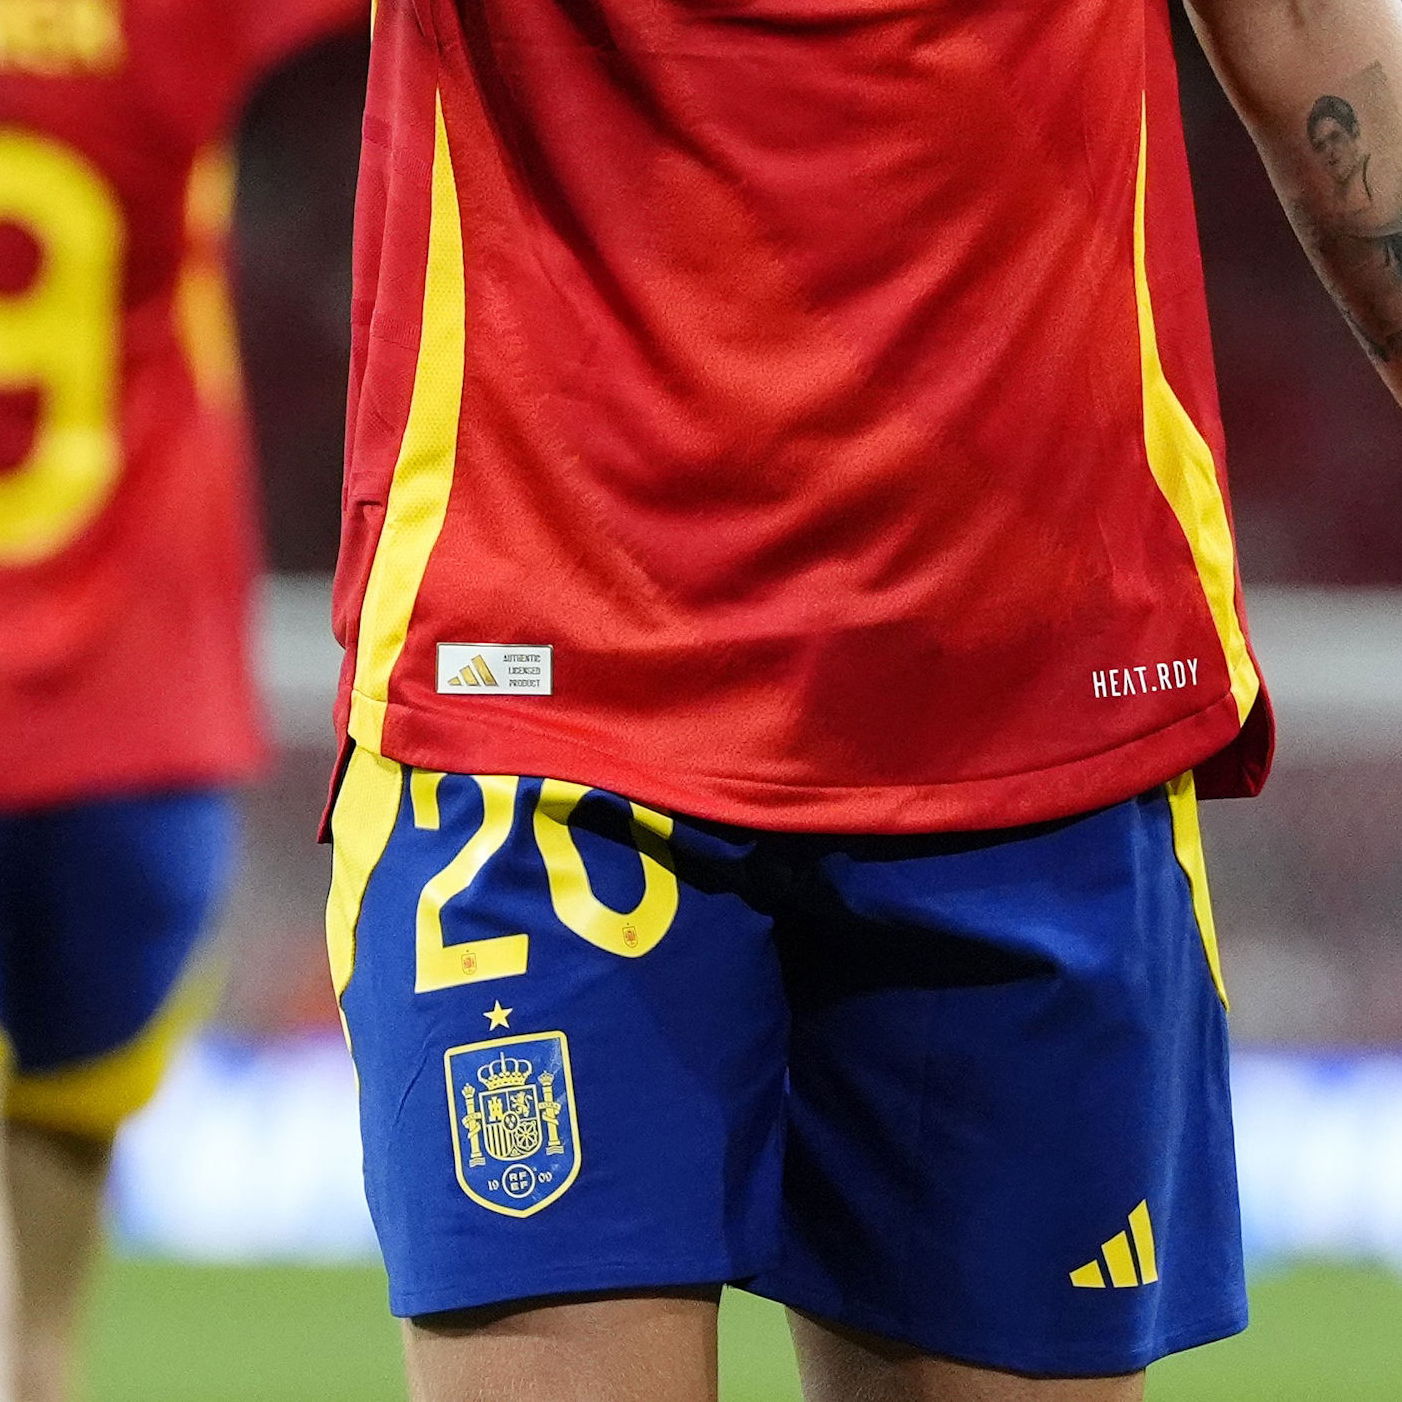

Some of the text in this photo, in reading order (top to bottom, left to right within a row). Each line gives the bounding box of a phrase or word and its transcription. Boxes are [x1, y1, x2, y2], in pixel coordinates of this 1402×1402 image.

[1092, 658, 1198, 698] HEAT.RDY
[409, 768, 680, 994] 20
[487, 1179, 500, 1191] 19
